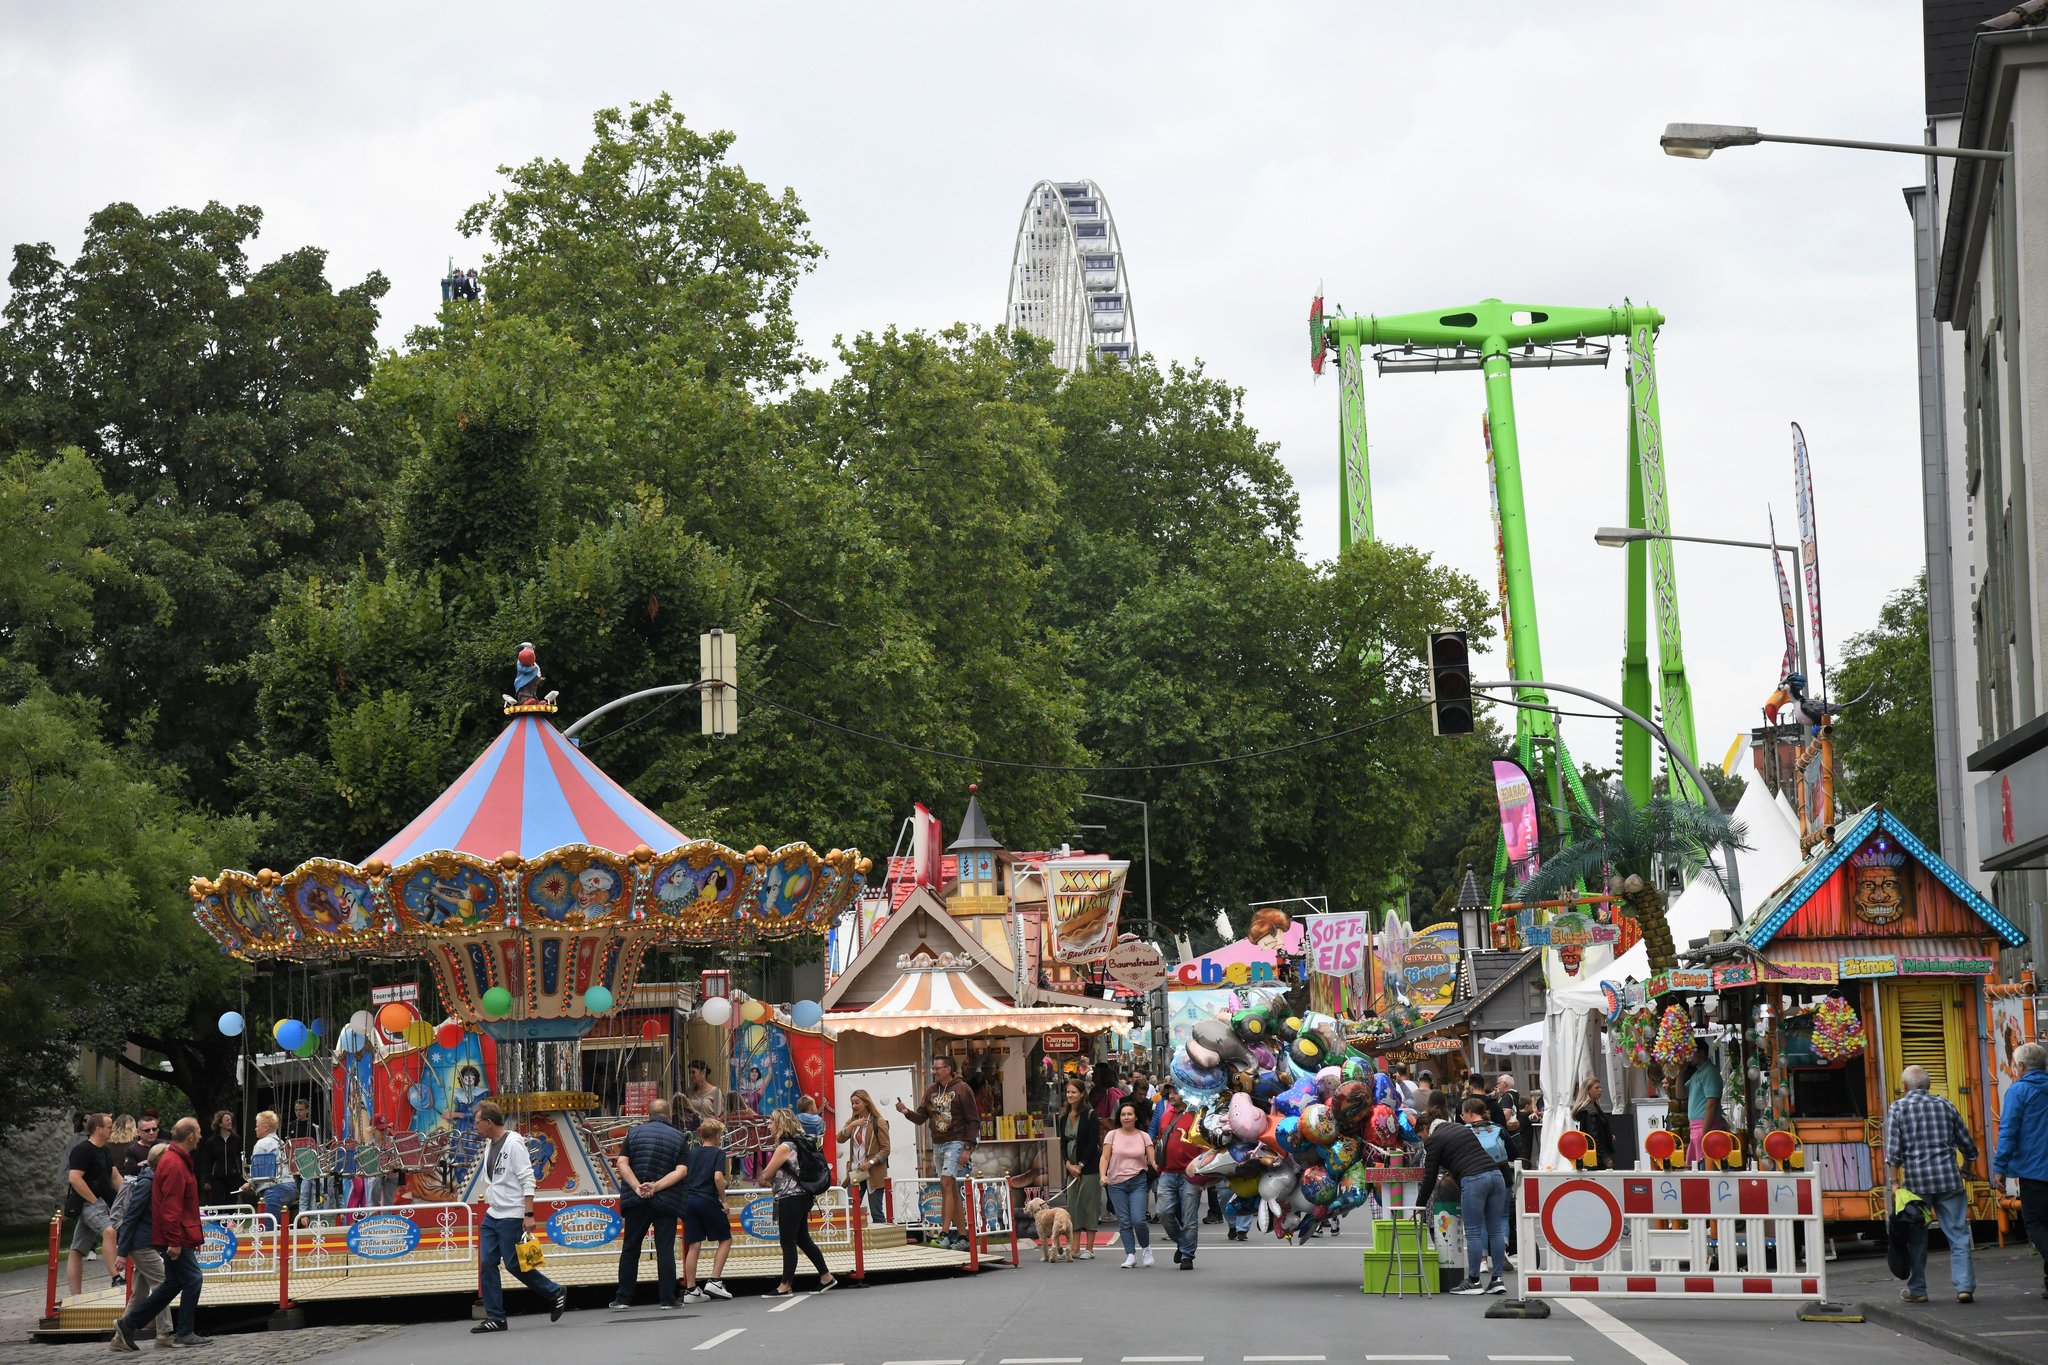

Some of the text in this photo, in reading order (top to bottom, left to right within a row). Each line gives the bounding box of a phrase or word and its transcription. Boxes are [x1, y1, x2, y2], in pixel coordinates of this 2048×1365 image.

[1311, 918, 1362, 950] SOFT
[1591, 926, 1616, 944] Bar
[1067, 944, 1108, 960] BAGUETTE
[1318, 940, 1361, 971] EIS
[1404, 954, 1425, 963] CHEZ
[1426, 953, 1447, 962] ALEX
[1177, 957, 1274, 986] chen
[1845, 958, 1896, 976] Zitrone
[1901, 957, 1993, 974] Waldmeister
[1671, 971, 1709, 990] Orange
[1415, 1040, 1461, 1051] CHEZ ALEX
[383, 1218, 409, 1228] Kinder
[556, 1209, 612, 1224] Für kleine
[561, 1221, 606, 1233] Kinder
[202, 1231, 229, 1243] kleine
[381, 1239, 405, 1247] Kinder
[565, 1233, 604, 1243] geeignet
[199, 1242, 225, 1252] inder
[196, 1254, 222, 1263] eeignet
